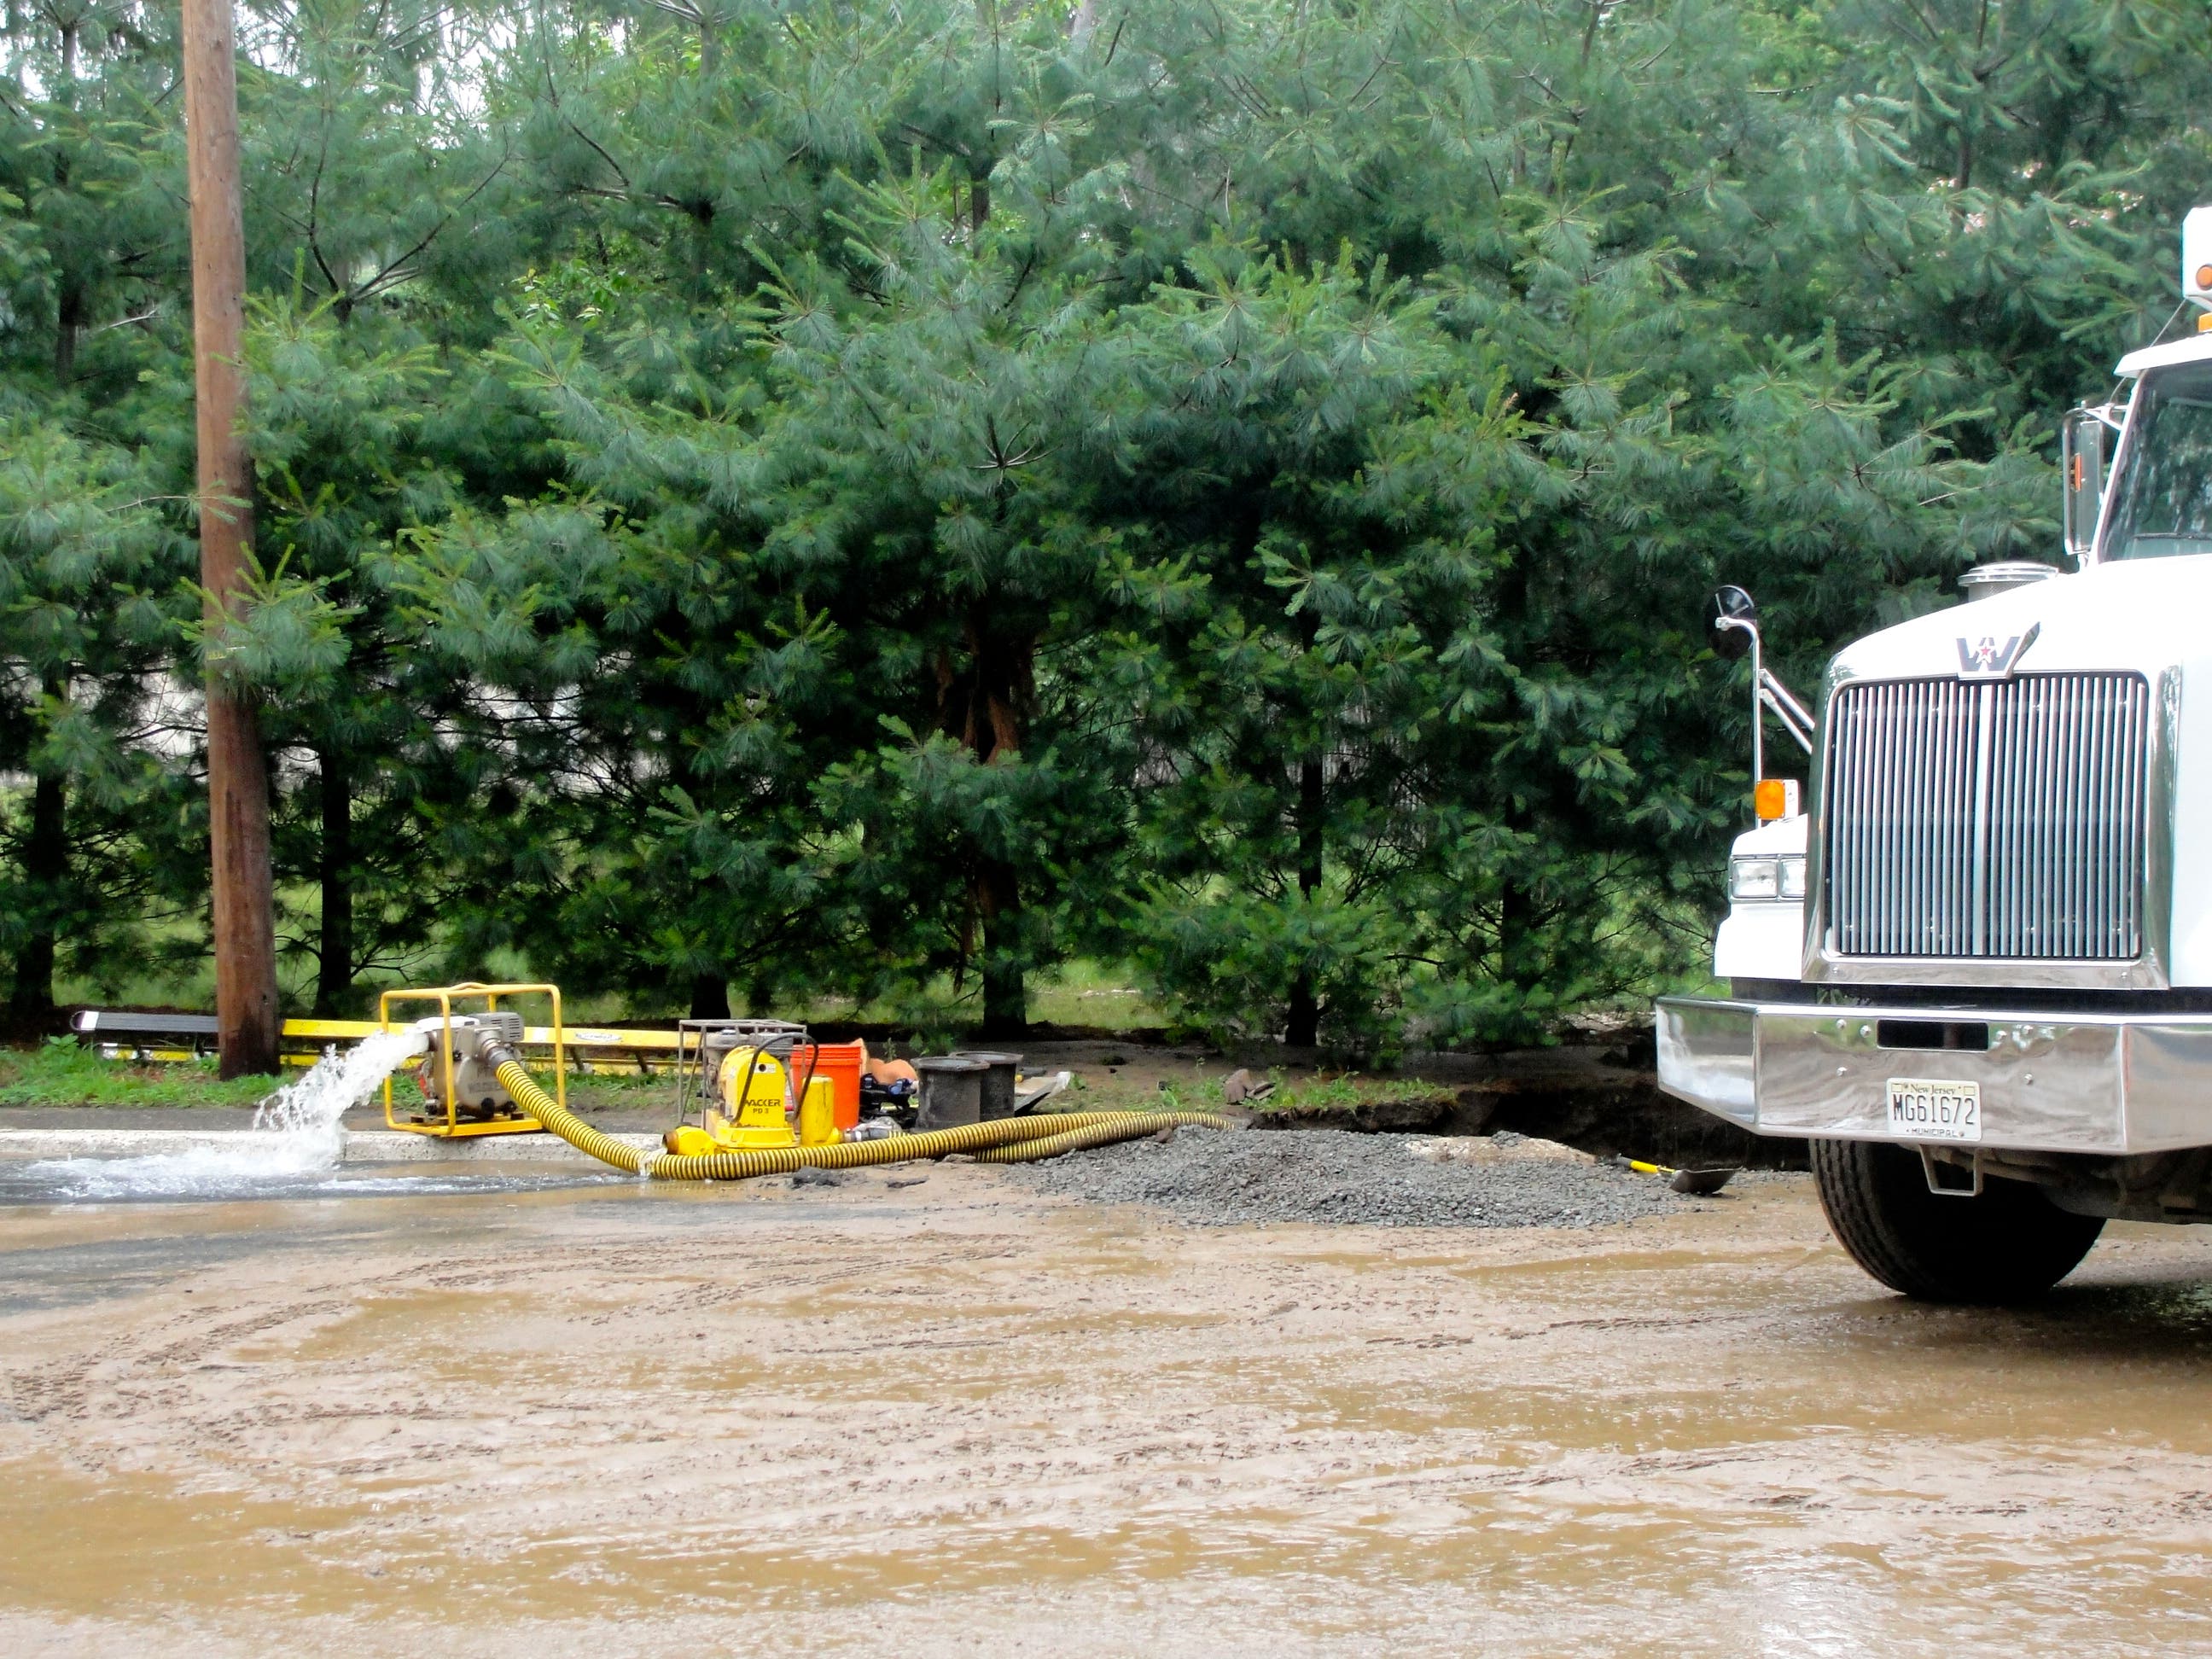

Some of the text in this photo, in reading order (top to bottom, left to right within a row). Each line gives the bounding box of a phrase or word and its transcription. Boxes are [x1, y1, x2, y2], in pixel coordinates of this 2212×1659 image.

[1911, 1084, 1955, 1095] New Jersey
[1893, 1094, 1974, 1125] MG61672
[1911, 1128, 1958, 1138] MUNICIPAL
